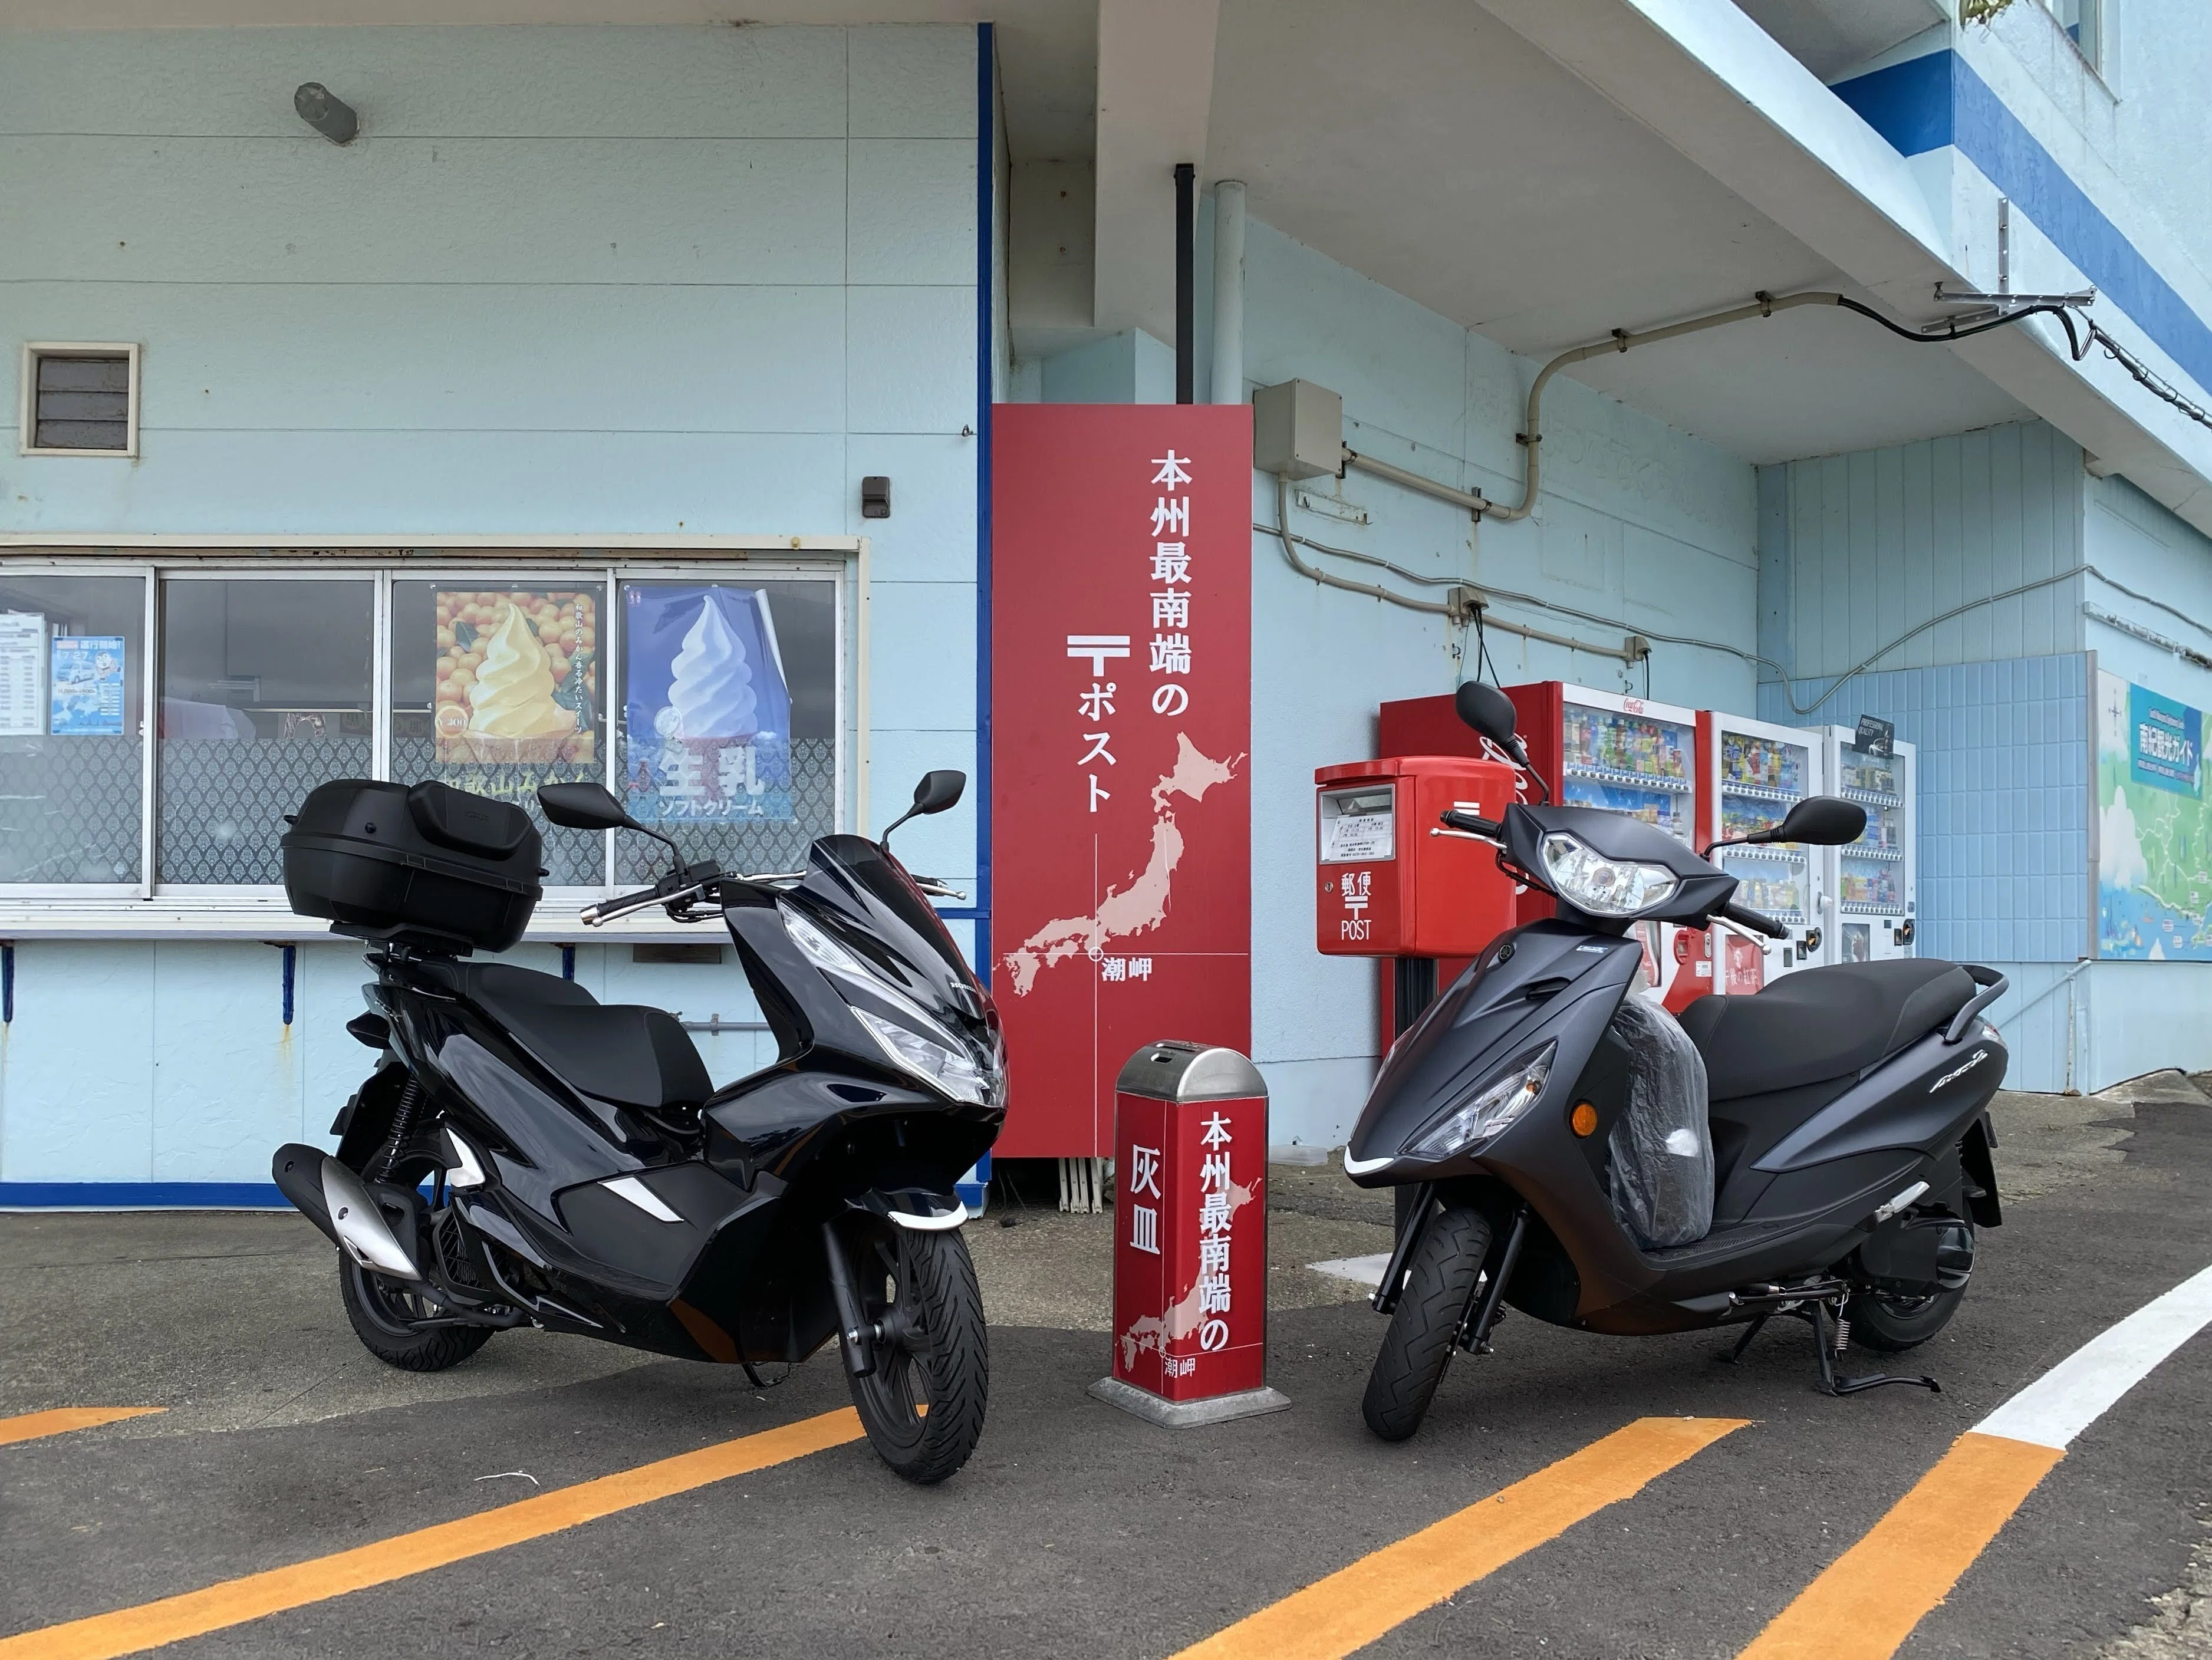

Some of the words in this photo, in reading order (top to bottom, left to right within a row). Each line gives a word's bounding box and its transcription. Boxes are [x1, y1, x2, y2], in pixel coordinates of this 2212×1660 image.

[1149, 449, 1193, 717] 本州最南端の
[1858, 726, 1874, 737] QUALITY
[2138, 722, 2193, 767] 南紀観光ガイド
[658, 746, 765, 796] 生乳
[659, 799, 765, 816] ソフトクリーム
[1341, 871, 1372, 897] 郵便
[1341, 920, 1372, 941] POST
[1101, 957, 1153, 982] 潮岬
[1130, 1143, 1161, 1255] 灰皿
[1199, 1111, 1233, 1351] 本州最南端の
[1164, 1356, 1196, 1379] 潮岬
